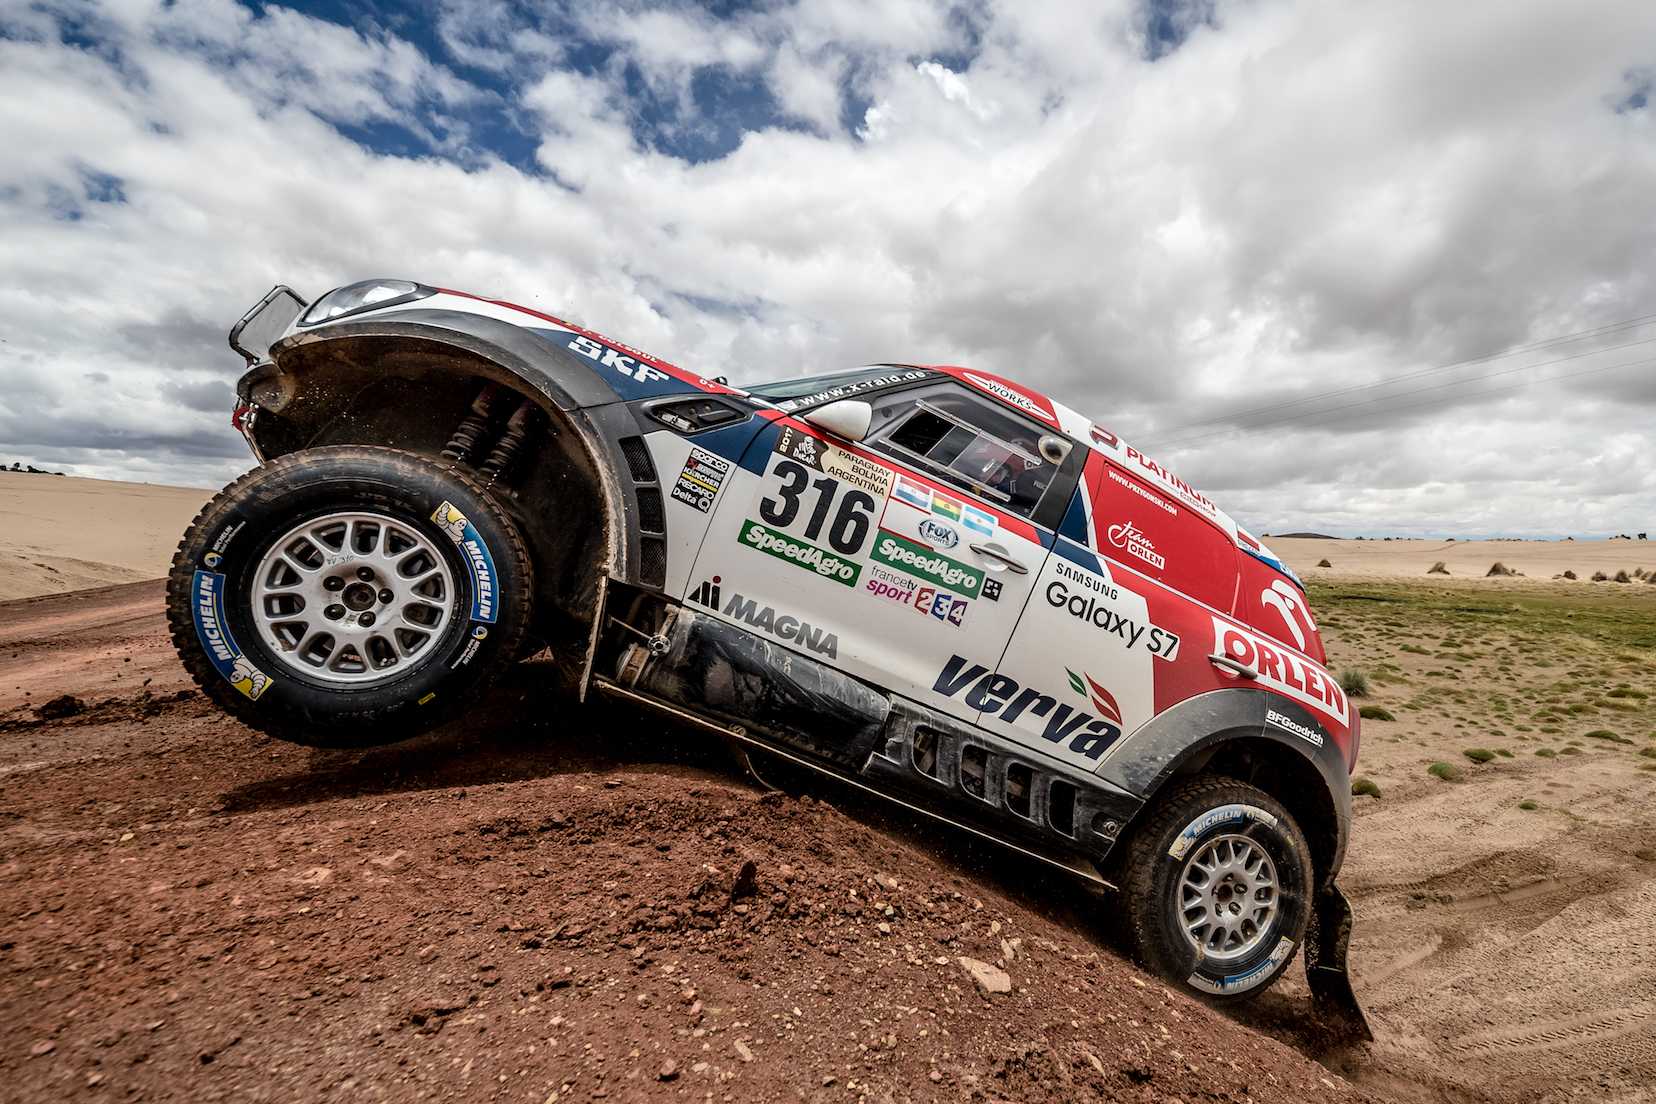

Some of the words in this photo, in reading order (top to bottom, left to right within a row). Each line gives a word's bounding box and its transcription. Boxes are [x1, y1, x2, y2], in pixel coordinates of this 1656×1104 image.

[568, 336, 669, 383] SKF
[987, 383, 1032, 409] WORKS
[779, 426, 794, 452] 2017
[827, 466, 884, 496] ARGENTINA
[838, 450, 891, 476] PARAGUAY
[851, 464, 888, 486] BOLIVIA
[673, 487, 697, 505] Delta
[760, 460, 875, 555] 316
[928, 521, 952, 540] FOX
[746, 525, 854, 580] SpeedAgro
[879, 538, 977, 589] SpeedAgro
[1129, 543, 1163, 567] ORLEN
[465, 540, 492, 619] MICHELIN
[866, 580, 912, 604] sport
[871, 565, 918, 591] francetv
[1056, 562, 1118, 600] SAMSUNG
[199, 575, 232, 661] MICHELIN
[722, 593, 838, 660] MAGNA
[1046, 581, 1144, 648] Galaxy
[1146, 628, 1178, 658] S7
[1224, 629, 1345, 717] ORLEN
[932, 654, 1121, 760] verva
[1267, 709, 1324, 744] BFGoodrich
